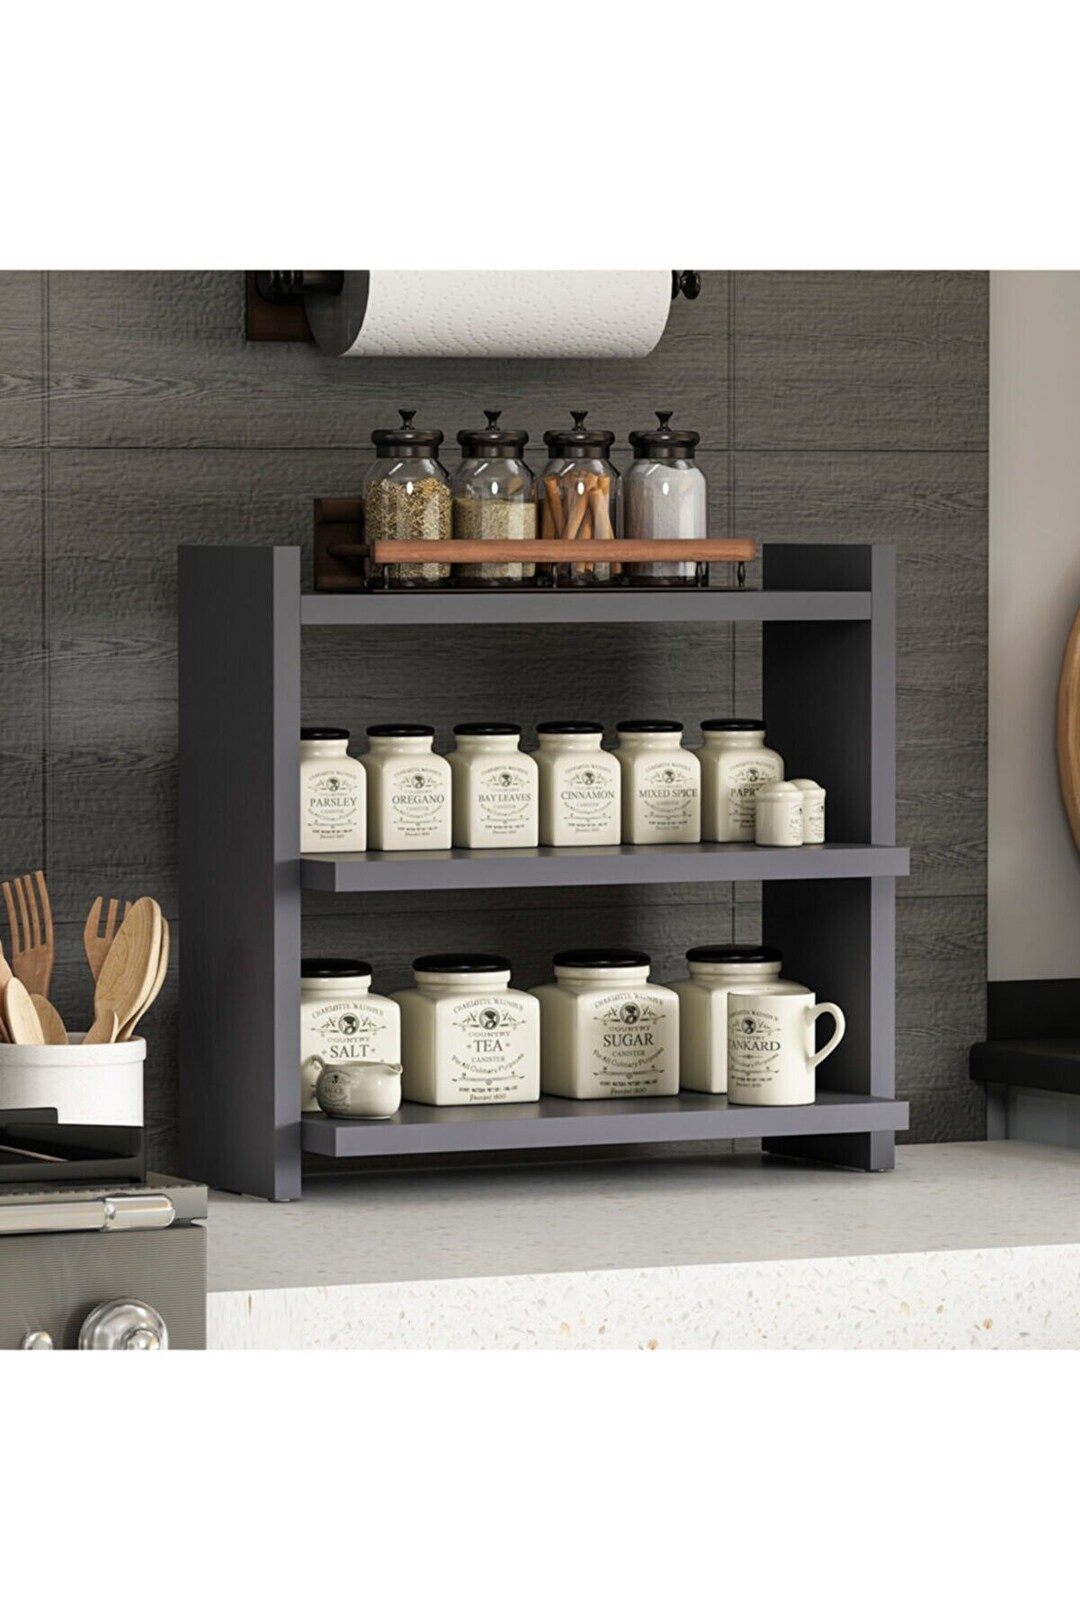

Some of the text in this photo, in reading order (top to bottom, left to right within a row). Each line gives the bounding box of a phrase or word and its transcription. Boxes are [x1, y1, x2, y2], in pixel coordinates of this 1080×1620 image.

[478, 793, 532, 803] BAY LEAVES
[560, 791, 615, 801] CINNAMON
[639, 788, 698, 799] MIXED SPICE
[730, 788, 760, 798] PAPR
[310, 797, 358, 807] PARSLEY
[392, 794, 445, 805] OREGANO
[602, 1032, 655, 1048] SUGAR
[729, 1040, 781, 1051] ANKARD
[330, 1044, 370, 1058] SALT
[473, 1039, 503, 1053] TEA
